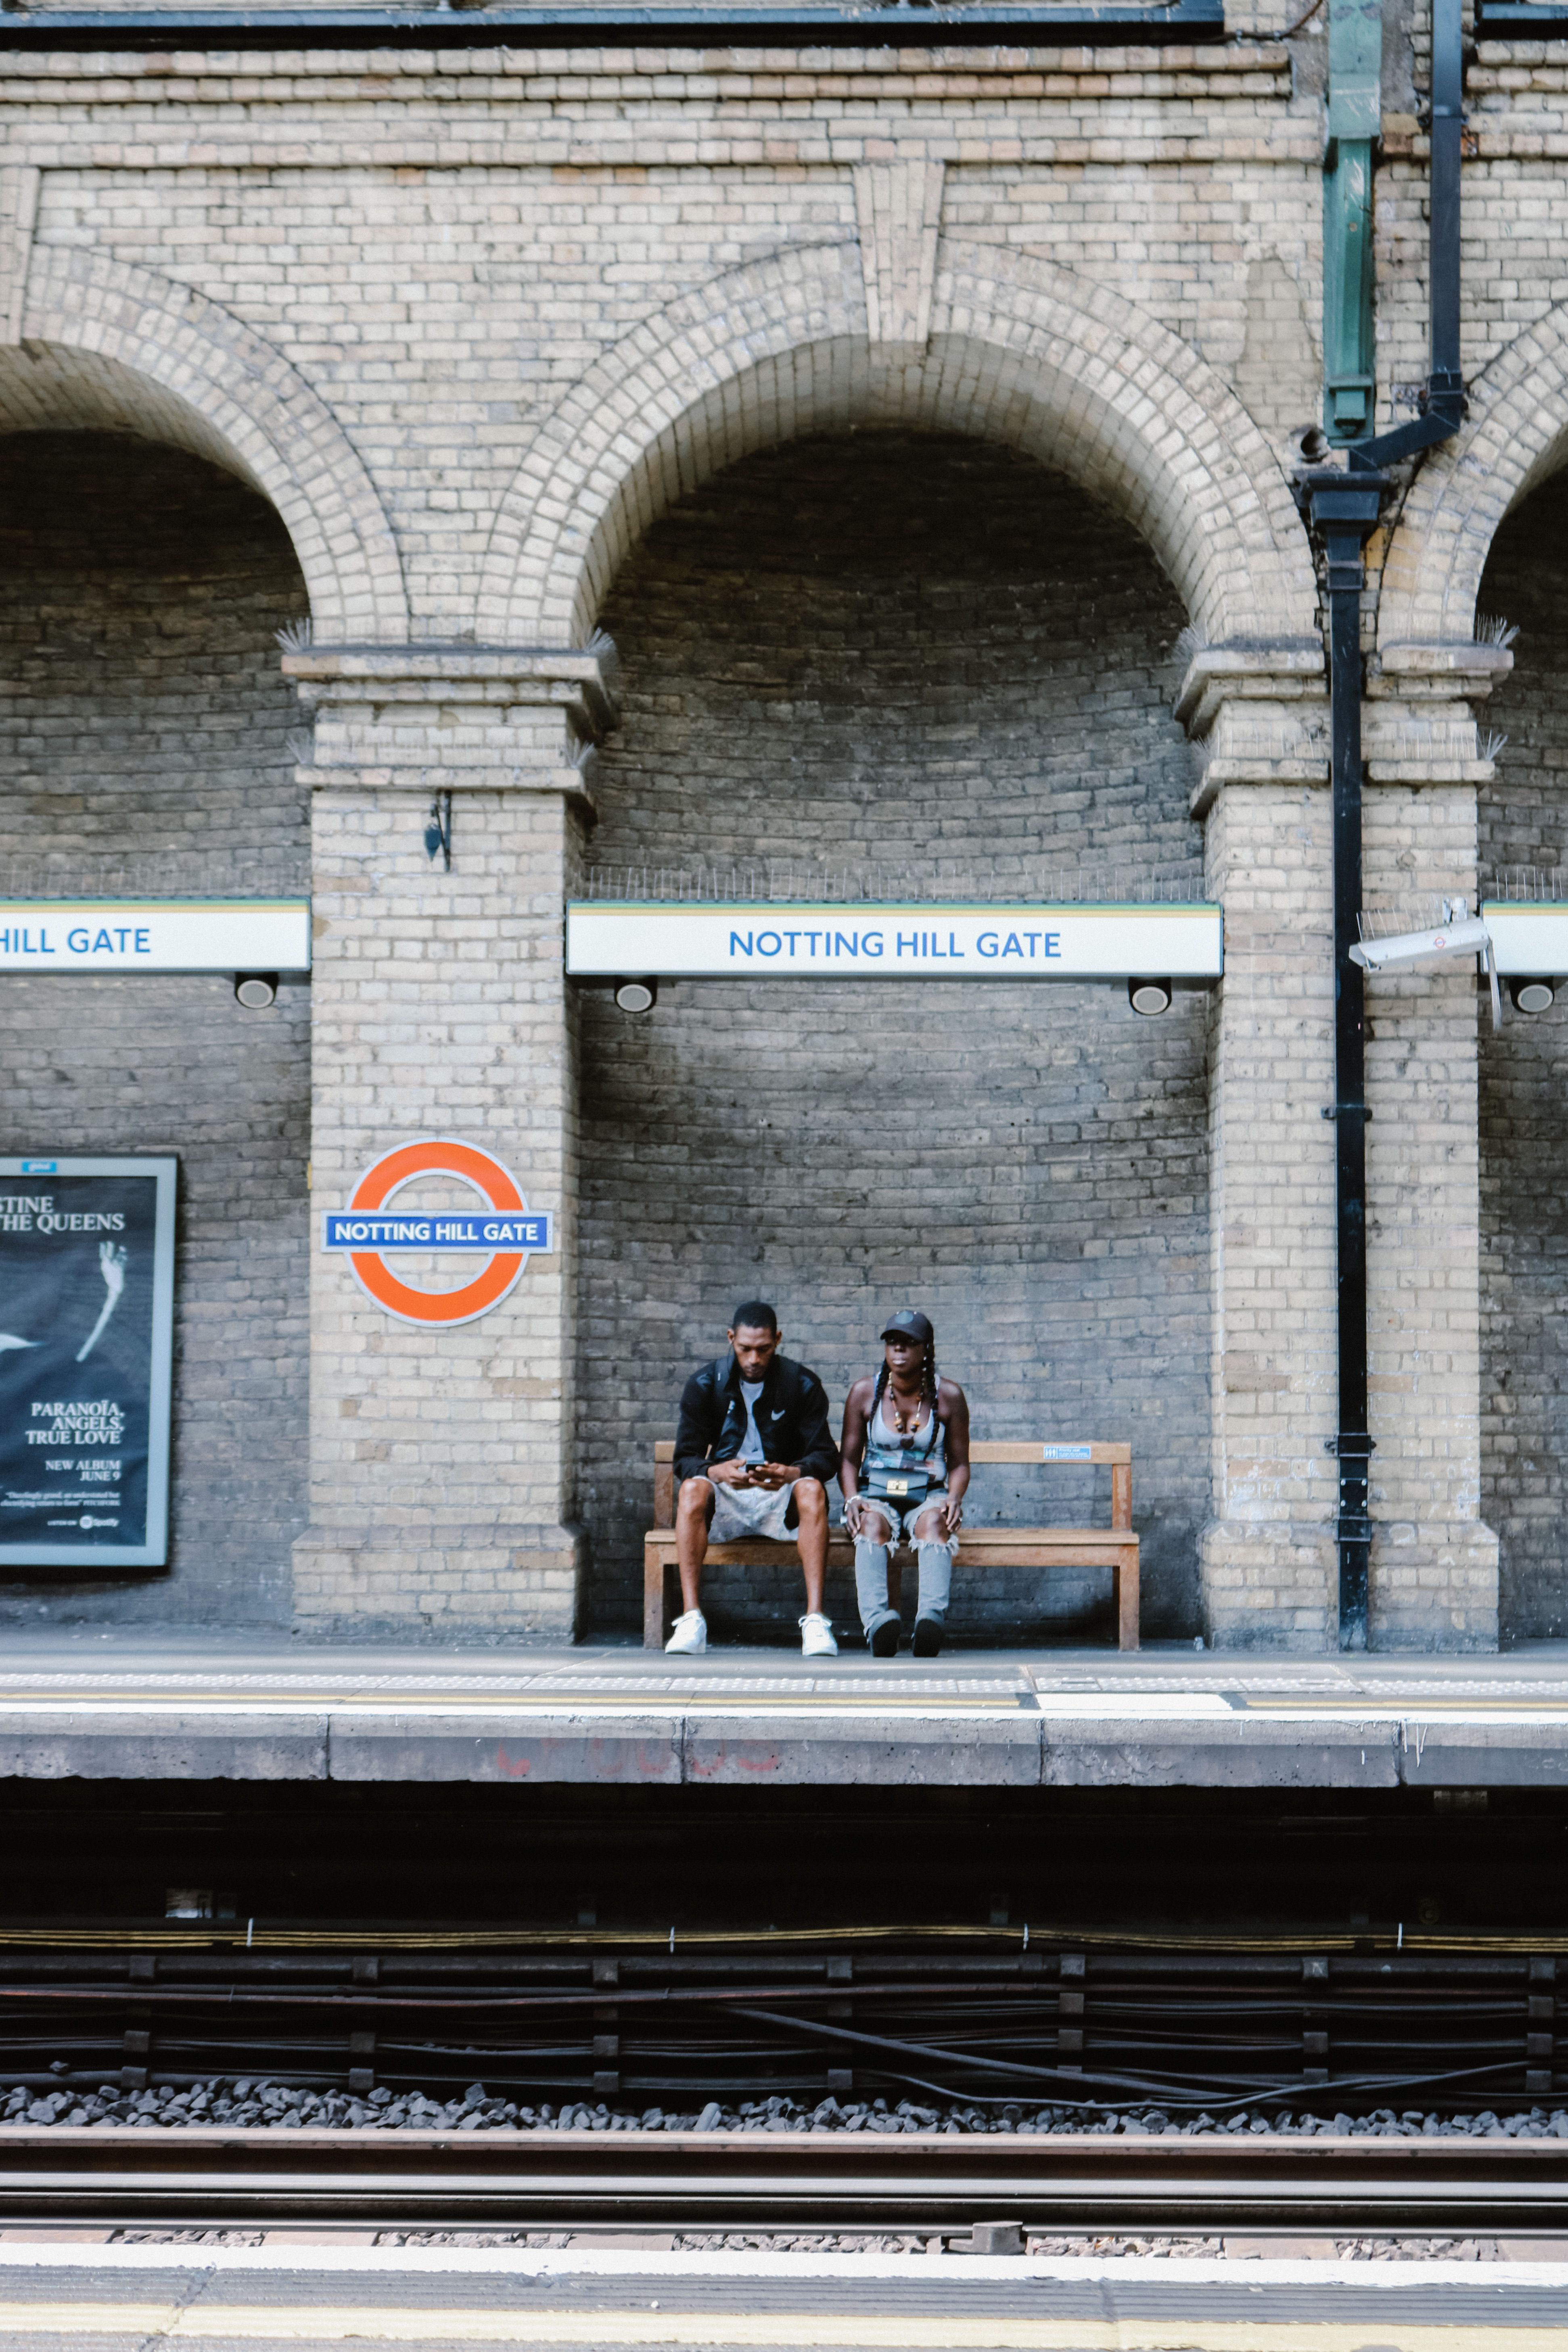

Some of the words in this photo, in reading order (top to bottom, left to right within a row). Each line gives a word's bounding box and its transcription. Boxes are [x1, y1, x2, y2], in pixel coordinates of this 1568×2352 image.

[67, 928, 151, 953] GATE
[730, 931, 884, 958] NOTTING
[897, 932, 965, 957] HILL
[976, 932, 1062, 958] GATE
[37, 1213, 125, 1234] QUEENS
[335, 1223, 431, 1241] NOTTING
[435, 1223, 478, 1241] HILL
[483, 1223, 538, 1241] GATE
[31, 1400, 125, 1417] PARANOÏA,
[52, 1416, 125, 1432] ANGELS,
[25, 1430, 71, 1445] TRUE
[74, 1430, 121, 1445] LOVE
[45, 1460, 74, 1471] NEW
[75, 1459, 121, 1470] ALBUM
[80, 1471, 111, 1481] JUNE
[113, 1471, 121, 1481] 9
